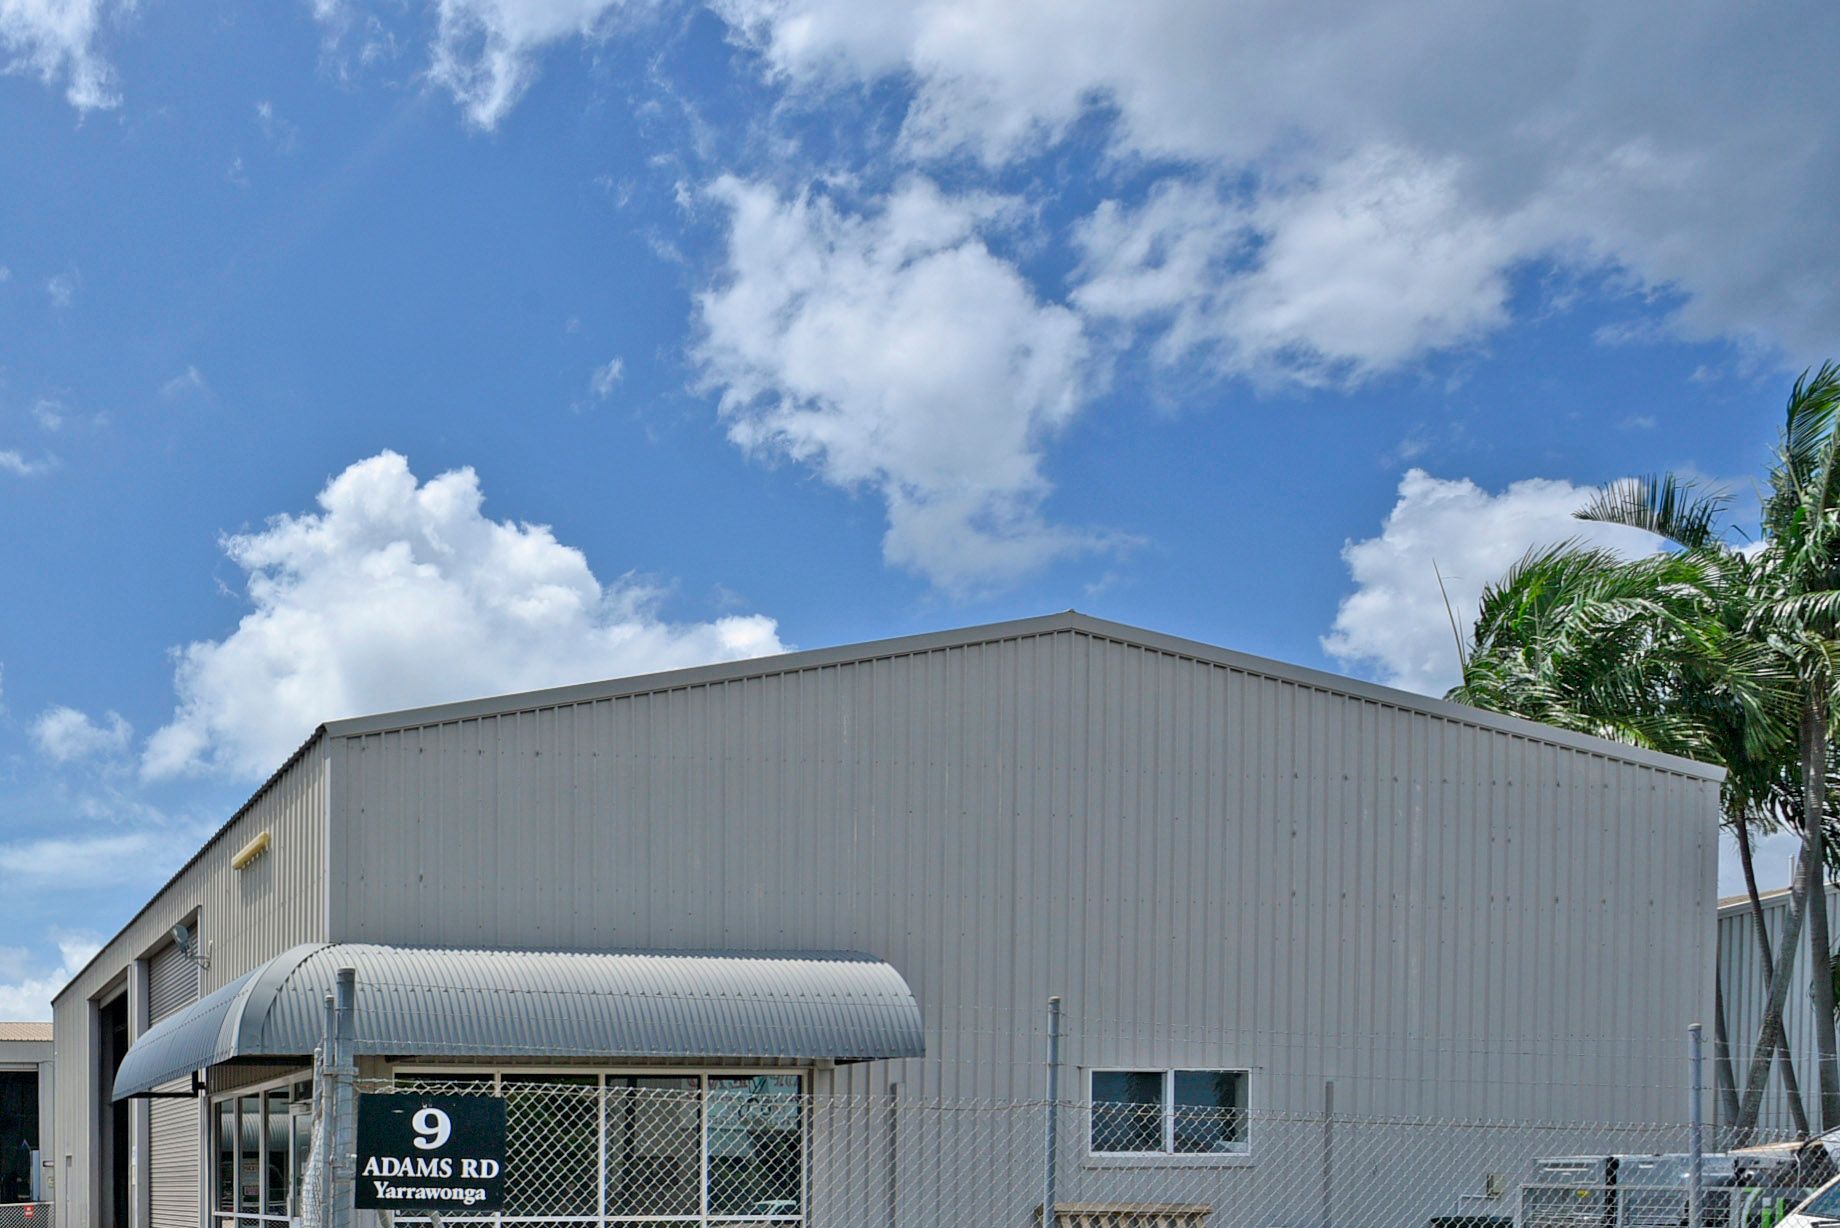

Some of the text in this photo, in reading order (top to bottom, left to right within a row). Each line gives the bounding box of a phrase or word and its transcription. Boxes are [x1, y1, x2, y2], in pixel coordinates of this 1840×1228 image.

[411, 1107, 452, 1150] 9
[362, 1156, 500, 1179] ADAMS RD
[373, 1181, 487, 1206] Yarrawonga
